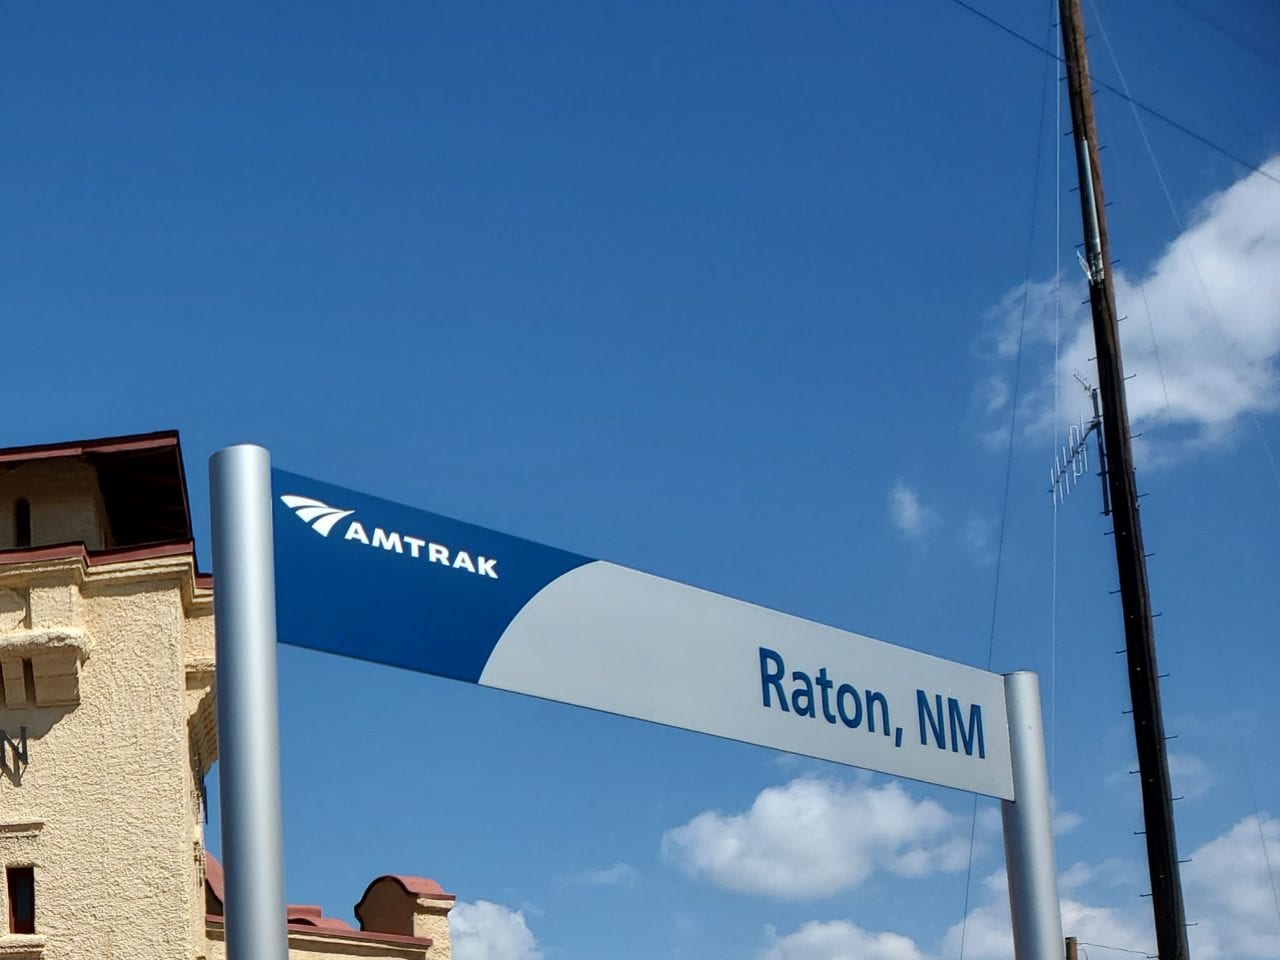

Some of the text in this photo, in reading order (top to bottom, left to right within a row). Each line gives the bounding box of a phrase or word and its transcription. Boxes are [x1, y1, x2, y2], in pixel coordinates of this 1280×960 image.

[344, 521, 499, 579] AMTRAK
[758, 646, 986, 760] Raton, NM
